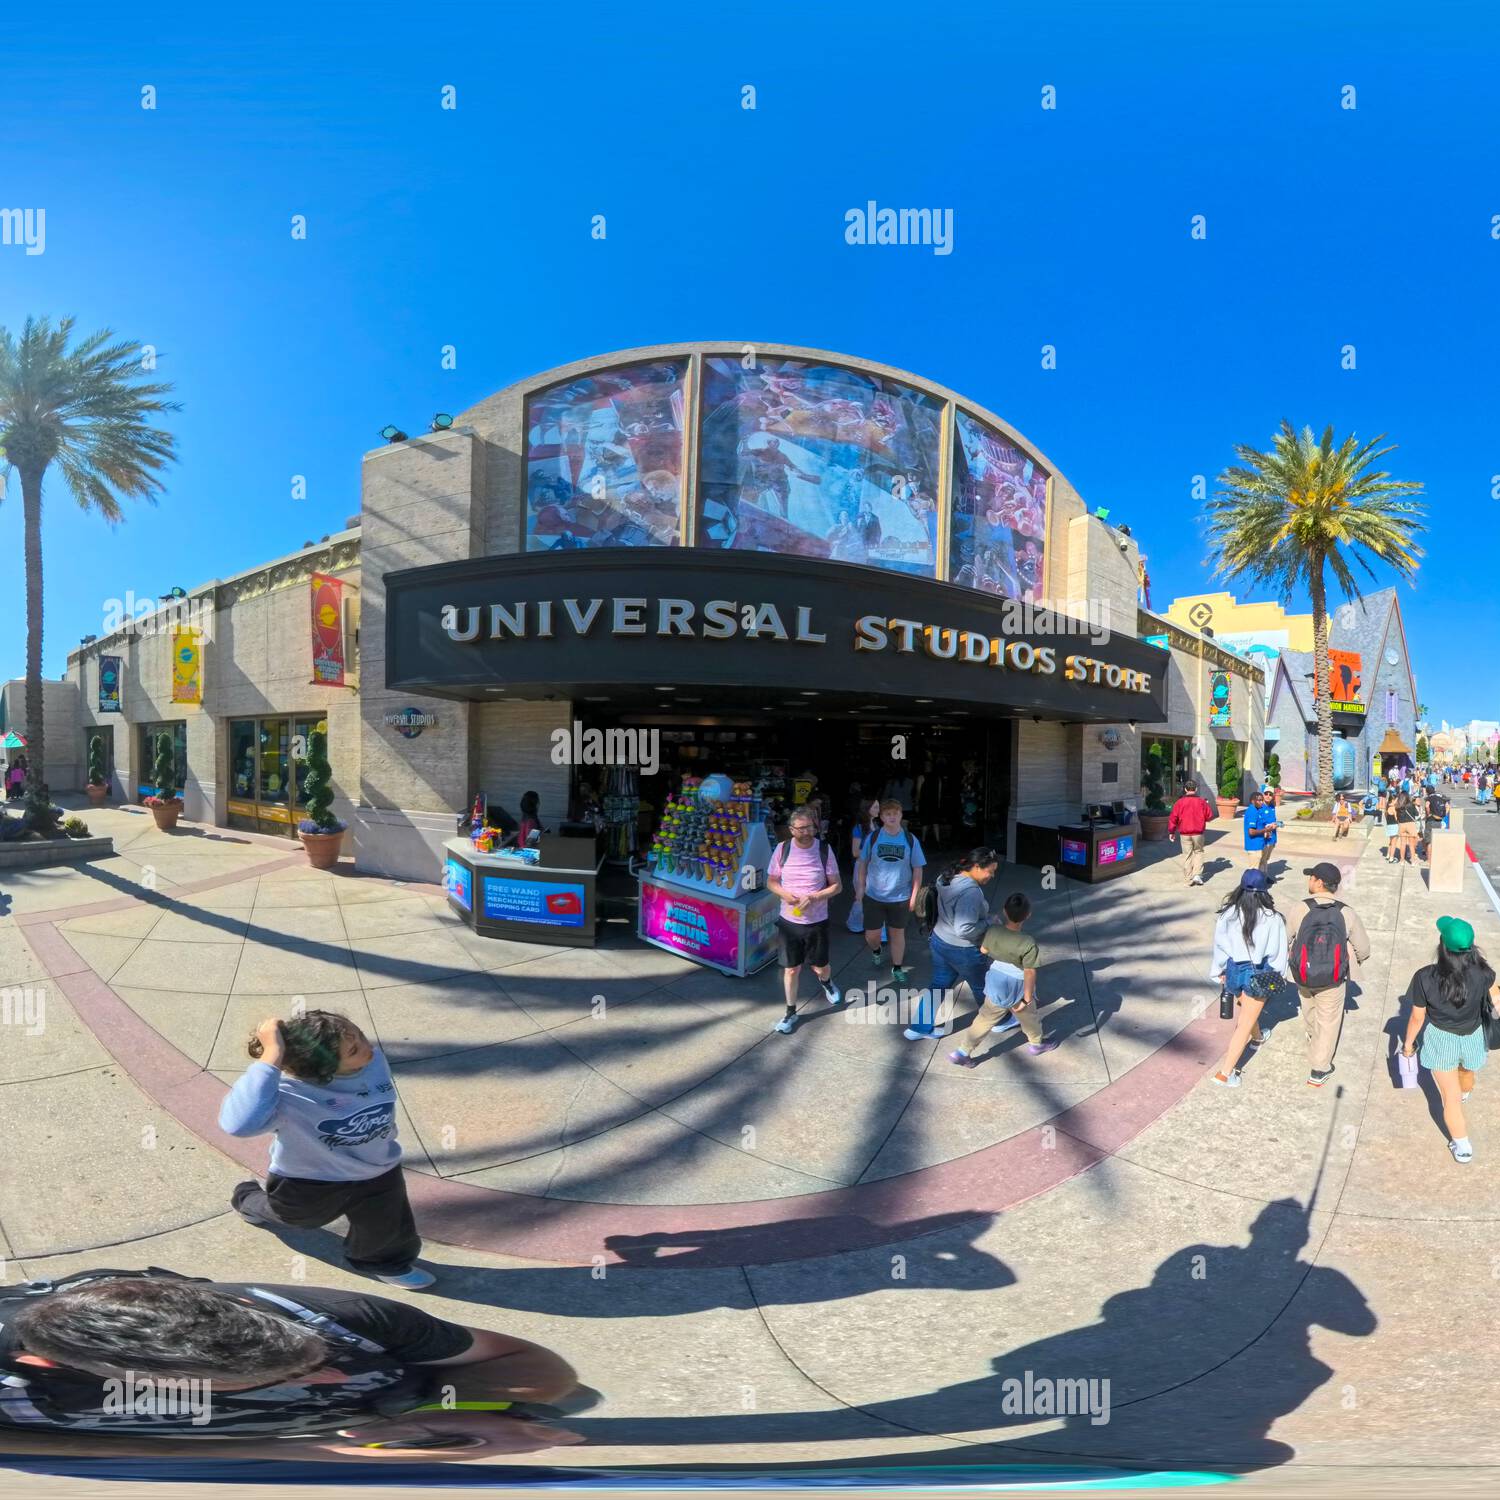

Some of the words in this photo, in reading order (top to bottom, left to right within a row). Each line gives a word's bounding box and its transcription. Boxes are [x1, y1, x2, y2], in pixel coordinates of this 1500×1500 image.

[447, 597, 827, 643] UNIVERSAL
[855, 615, 1056, 674] STUDIOS
[1064, 654, 1152, 694] STORE
[1343, 703, 1364, 713] MAYHEM
[410, 713, 435, 725] STUDIOS
[488, 884, 509, 893] FREE
[511, 887, 540, 896] WAND
[487, 896, 540, 906] MERCHANDISE
[487, 902, 520, 911] SHOPPING
[673, 901, 701, 914] UNIVERSAL
[666, 905, 708, 931] MEGA
[664, 919, 711, 946] MOVIE
[672, 935, 701, 950] PARADE
